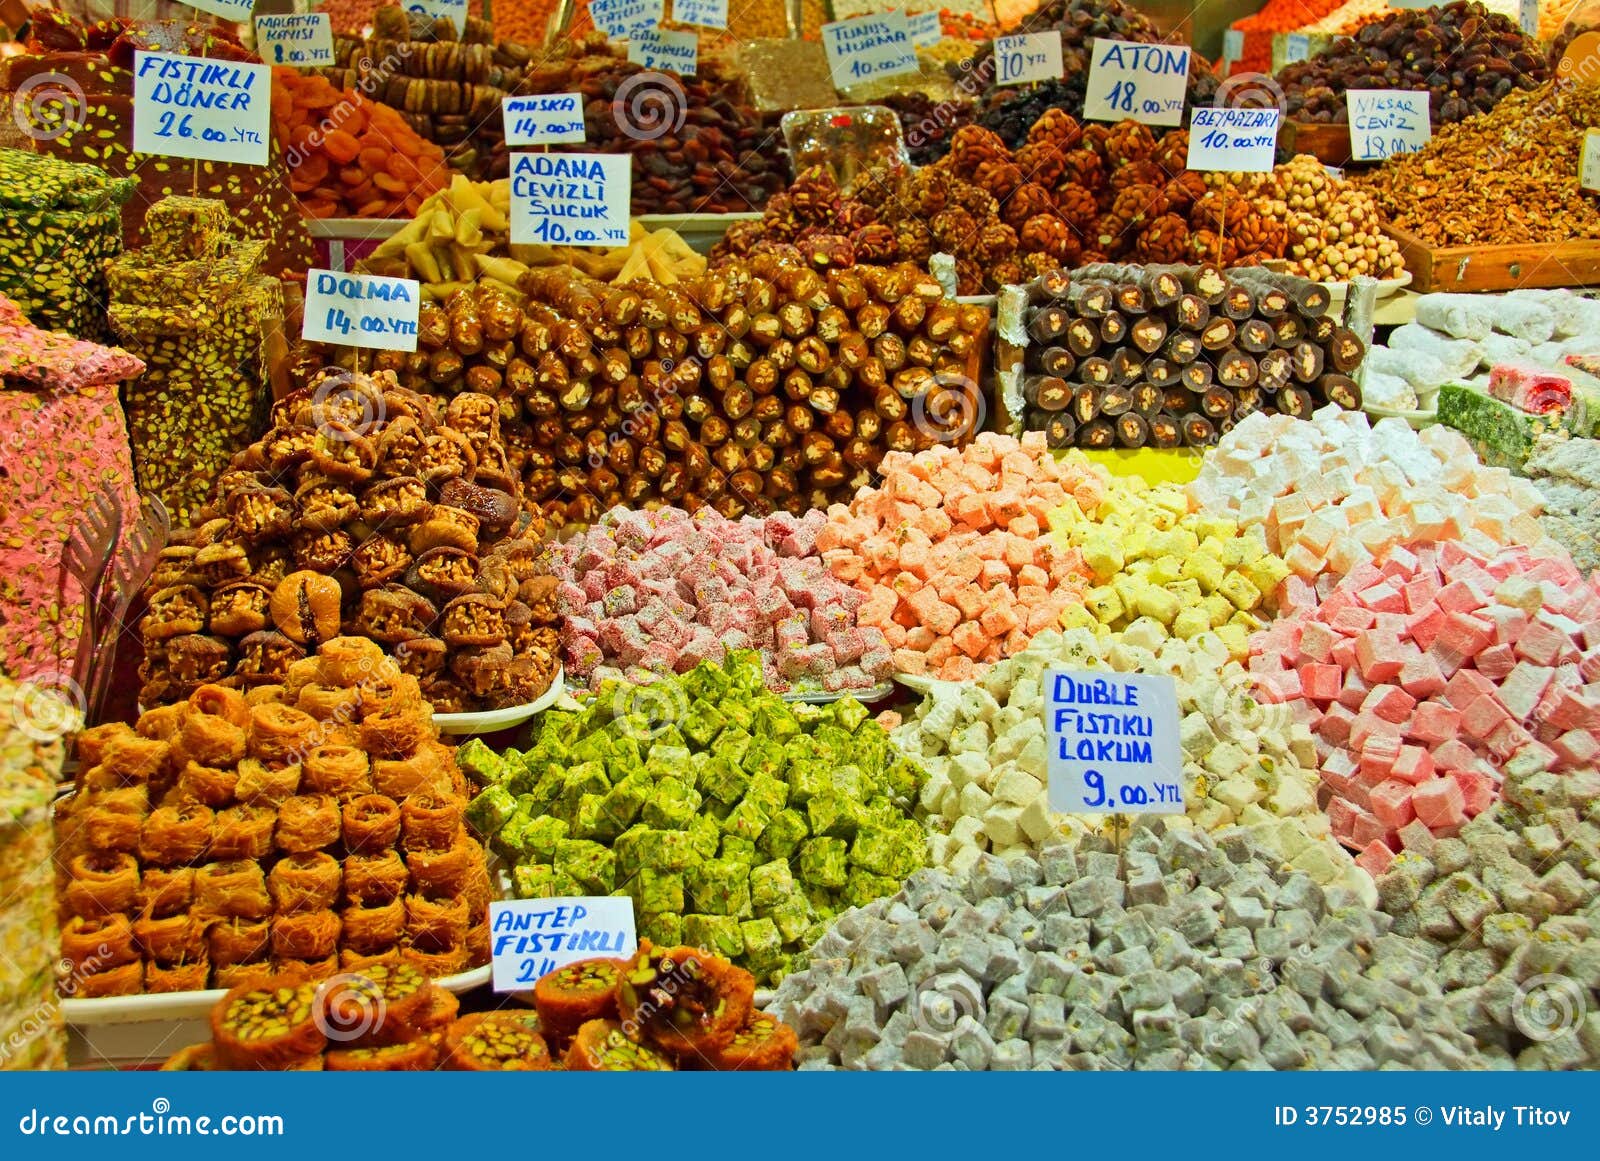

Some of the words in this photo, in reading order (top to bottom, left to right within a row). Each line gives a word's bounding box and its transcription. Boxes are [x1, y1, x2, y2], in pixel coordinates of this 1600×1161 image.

[257, 15, 320, 29] MALATYA
[836, 30, 907, 55] HURMA
[138, 56, 256, 90] FISTIKLI
[1099, 44, 1188, 76] ATOM
[150, 82, 251, 111] DÖNER
[507, 98, 575, 112] MUSKA
[1191, 110, 1279, 128] BEYPAZARI
[514, 156, 606, 181] ADANA
[529, 200, 609, 219] SUCUK
[317, 274, 411, 302] DOLMA
[1053, 674, 1138, 706] DUBLE
[1059, 736, 1153, 763] LOKUM
[493, 905, 588, 932] ANTEP
[493, 930, 626, 956] FISTIKLI
